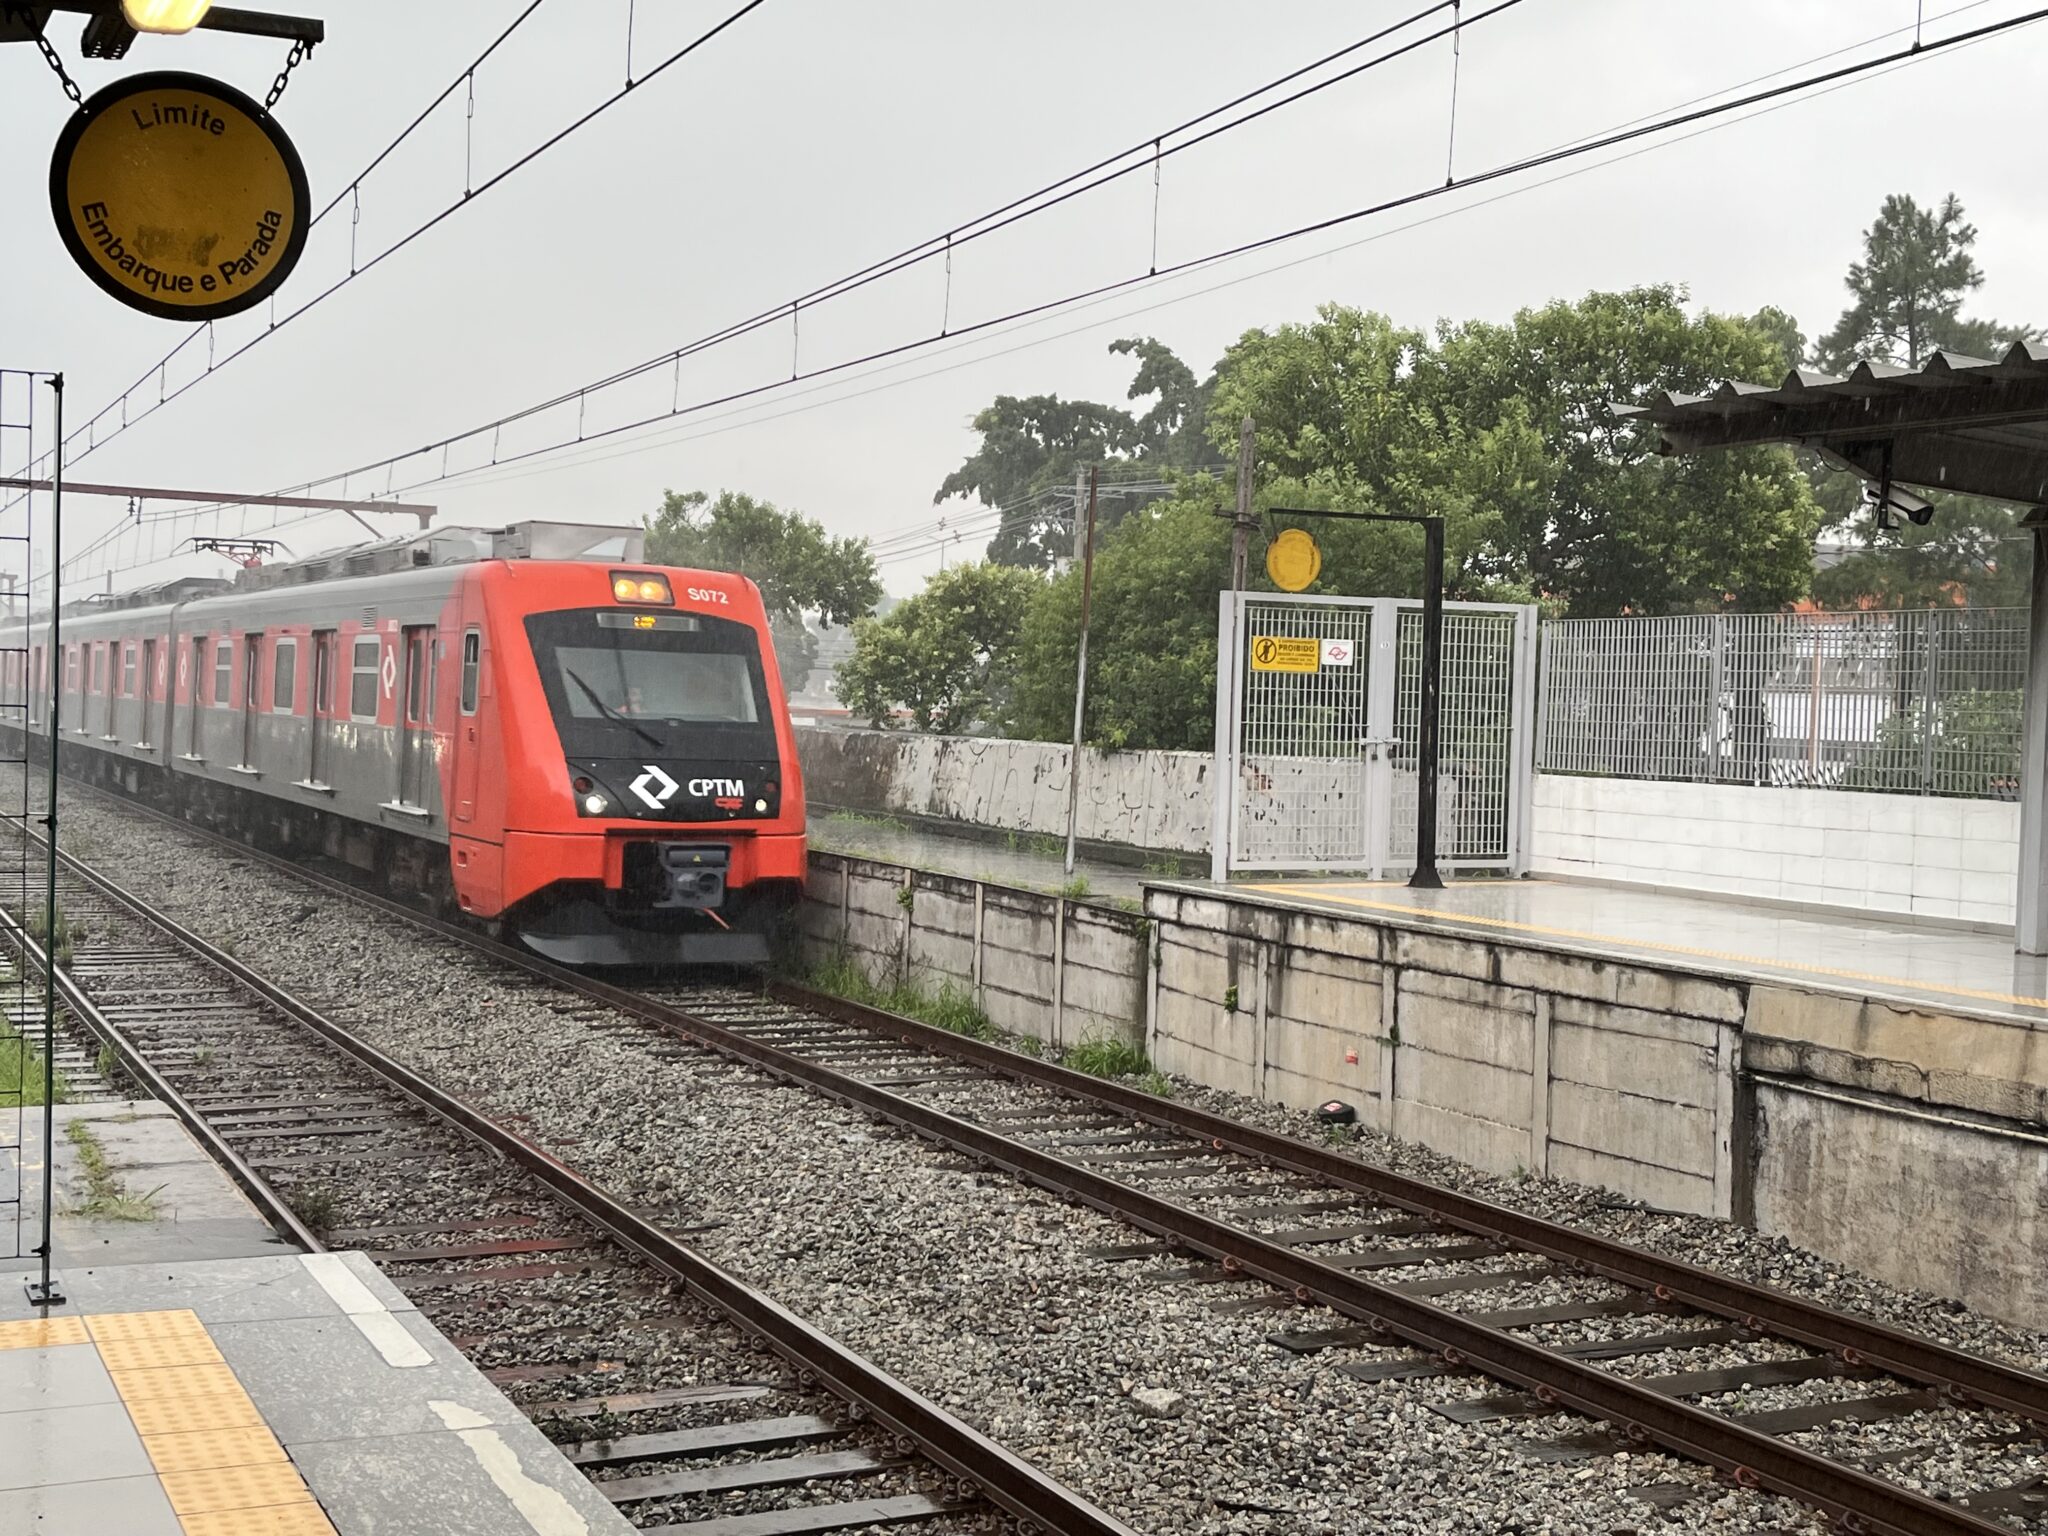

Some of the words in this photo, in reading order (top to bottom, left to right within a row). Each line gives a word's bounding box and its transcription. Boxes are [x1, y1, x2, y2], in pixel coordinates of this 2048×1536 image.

[132, 103, 225, 135] Limite
[82, 201, 193, 292] Embarque
[200, 272, 217, 291] e
[218, 210, 282, 284] Parada
[688, 588, 729, 604] S072
[1278, 644, 1315, 652] PROIBIDO
[688, 778, 744, 796] CPTM
